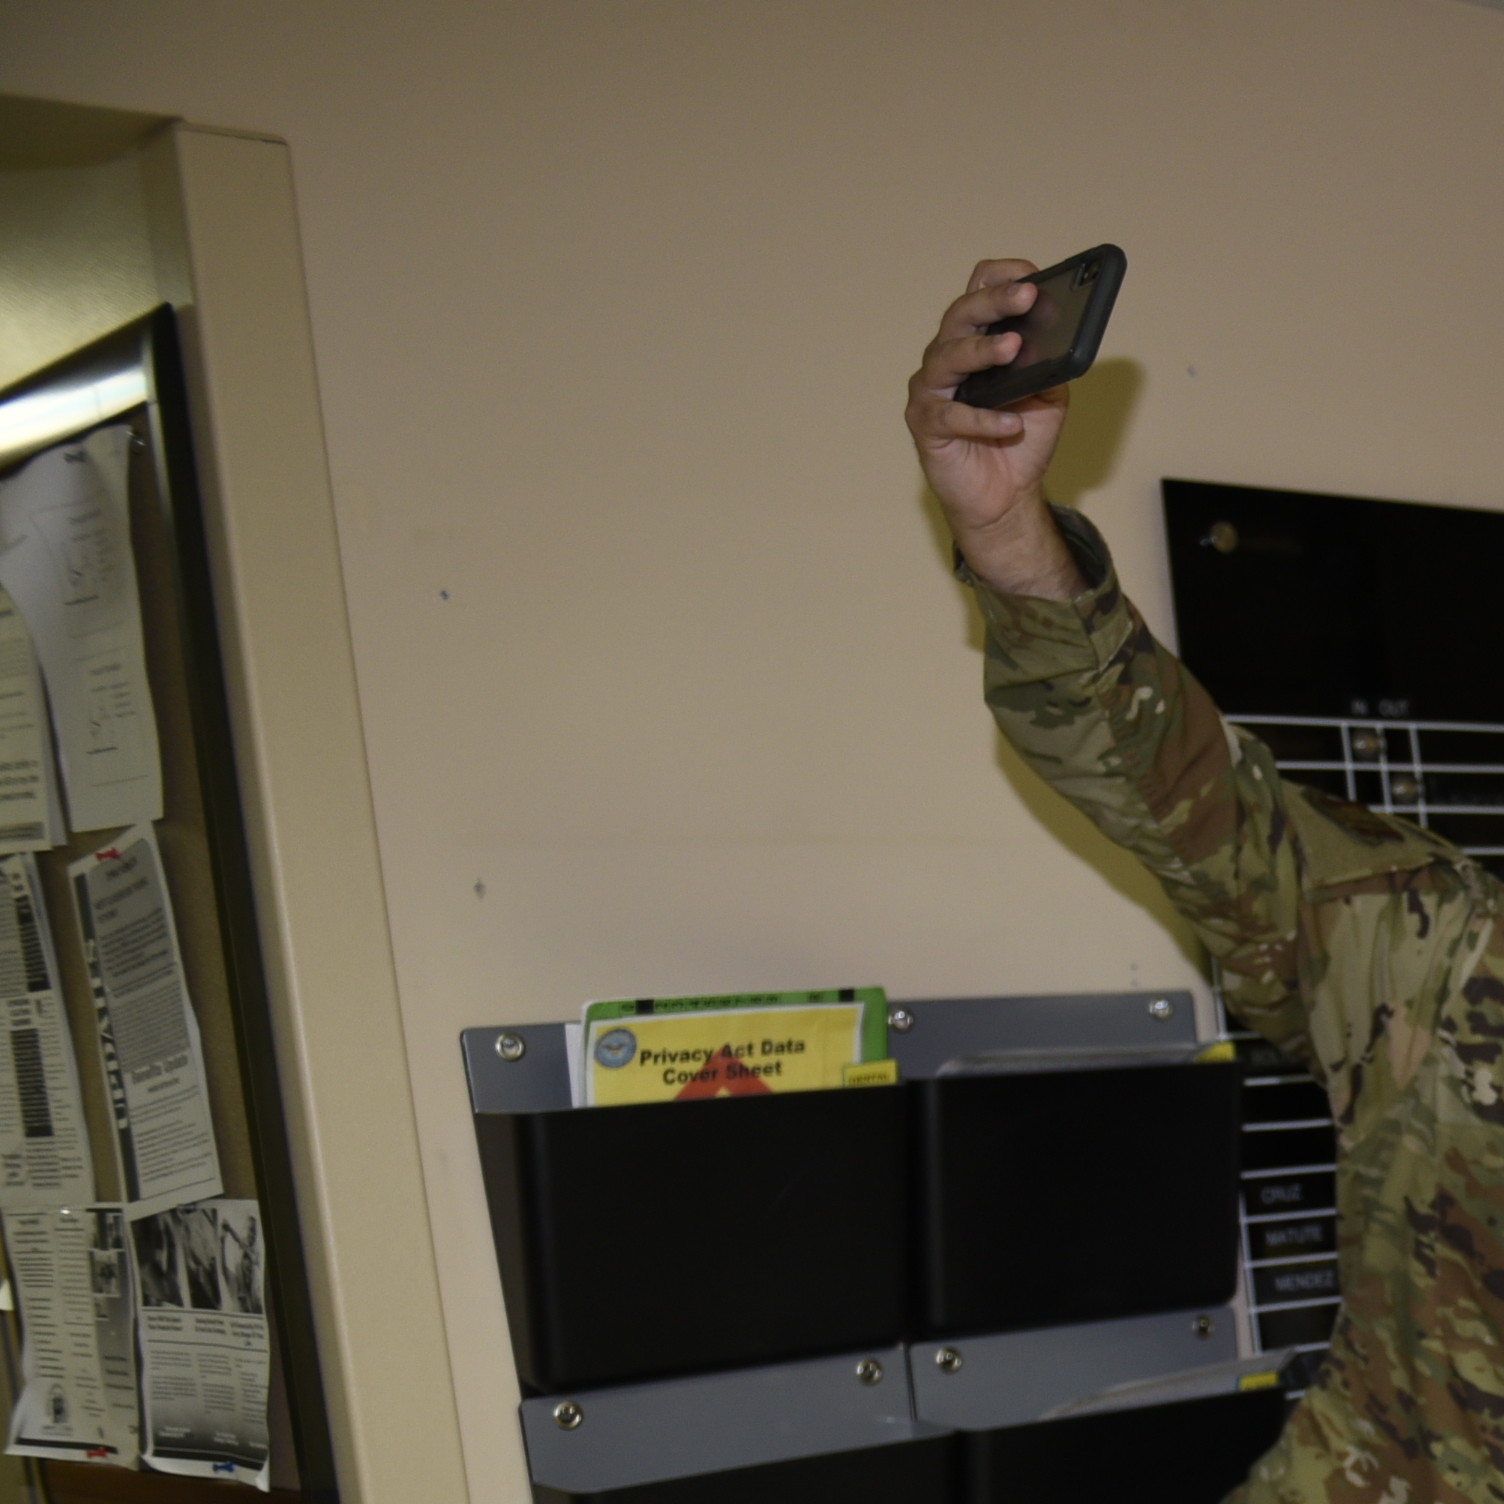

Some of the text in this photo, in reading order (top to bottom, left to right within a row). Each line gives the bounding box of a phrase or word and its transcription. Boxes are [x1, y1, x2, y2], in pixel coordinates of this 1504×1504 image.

[640, 1038, 806, 1066] Privacy Act Data
[662, 1061, 782, 1085] Cover Sheet
